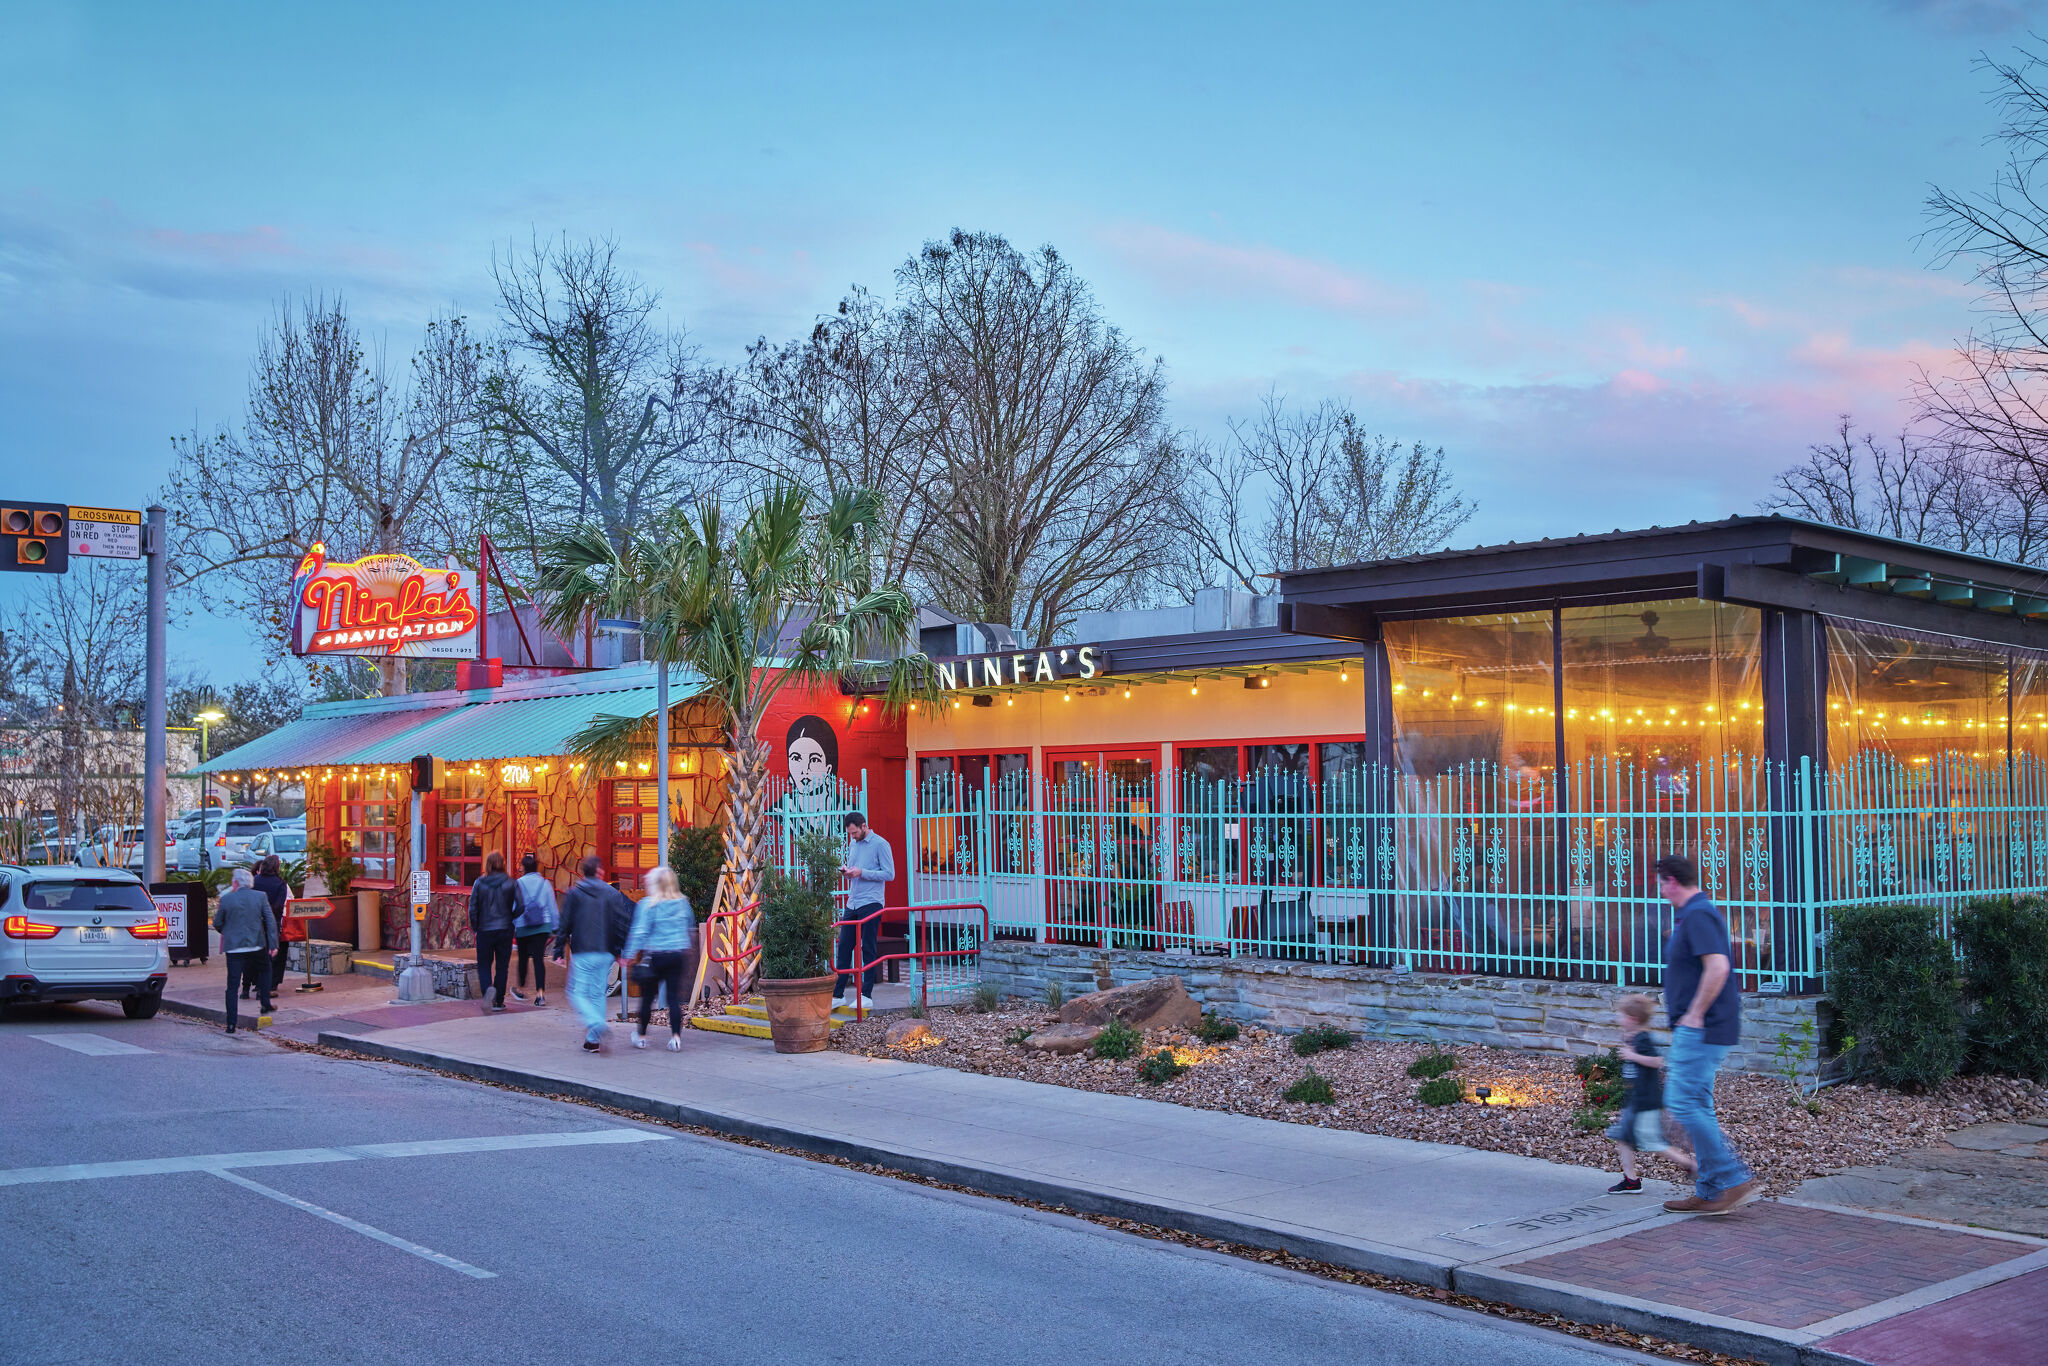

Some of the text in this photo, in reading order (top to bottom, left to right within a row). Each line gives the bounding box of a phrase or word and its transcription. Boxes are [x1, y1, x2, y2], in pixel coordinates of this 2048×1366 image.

[77, 511, 132, 522] CROSSWALK
[75, 522, 95, 531] STOP
[111, 524, 131, 533] STOP
[70, 530, 99, 540] ON RED
[359, 556, 417, 571] THE ORIGINAL
[334, 620, 465, 646] NAVIGATION
[938, 645, 1096, 691] NINFA'S
[503, 764, 531, 784] 2704
[1505, 1204, 1611, 1232] NAGLE
